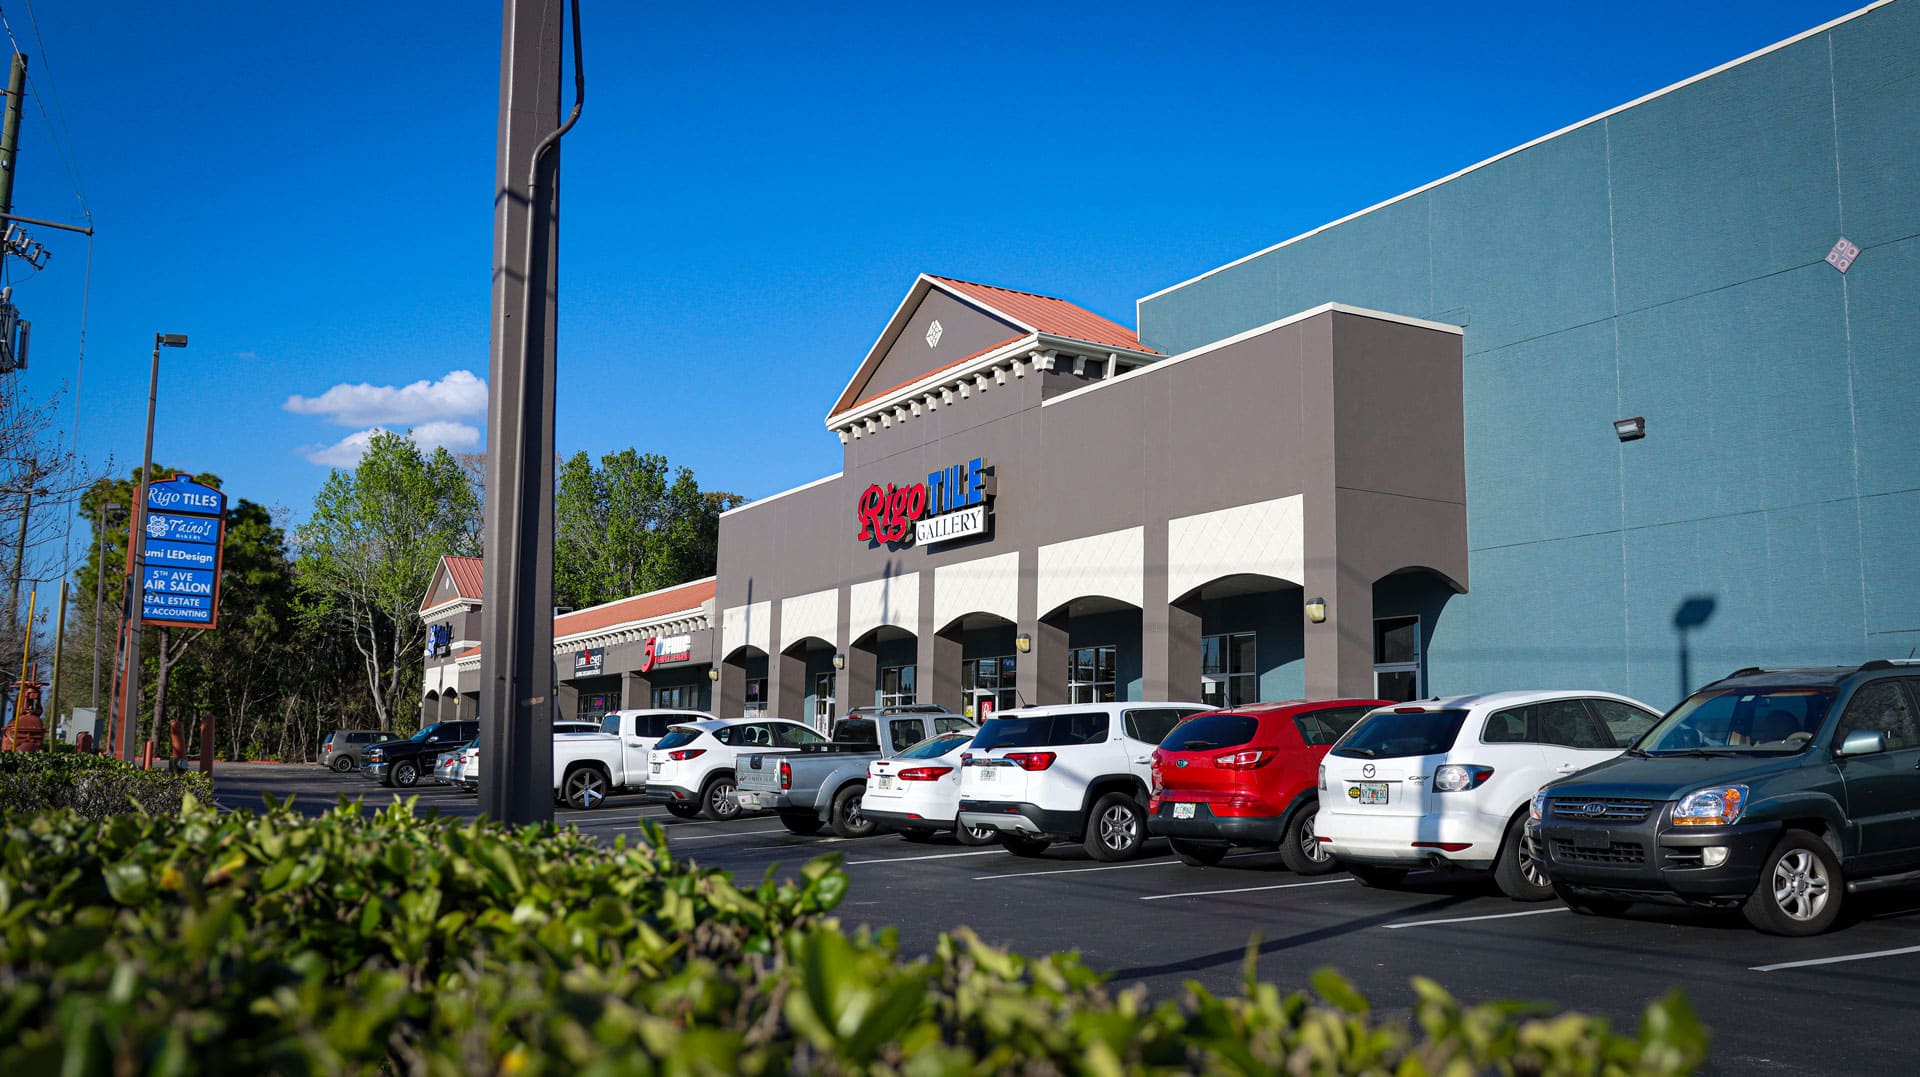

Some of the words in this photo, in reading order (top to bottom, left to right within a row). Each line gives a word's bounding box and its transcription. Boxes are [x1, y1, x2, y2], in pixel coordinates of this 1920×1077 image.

[148, 487, 181, 507] Rigo
[183, 493, 217, 508] TILES
[857, 482, 926, 544] Rigo
[927, 457, 984, 515] TILE
[917, 510, 981, 541] GALLERY
[144, 549, 164, 558] umi
[167, 549, 213, 564] LEDesign
[152, 569, 169, 579] 5TH
[171, 571, 193, 582] AVE
[143, 579, 165, 590] AIR
[169, 580, 211, 593] SALON
[167, 597, 200, 607] ESTATE
[151, 607, 208, 618] ACCOUNTING
[1586, 804, 1603, 813] KIA
